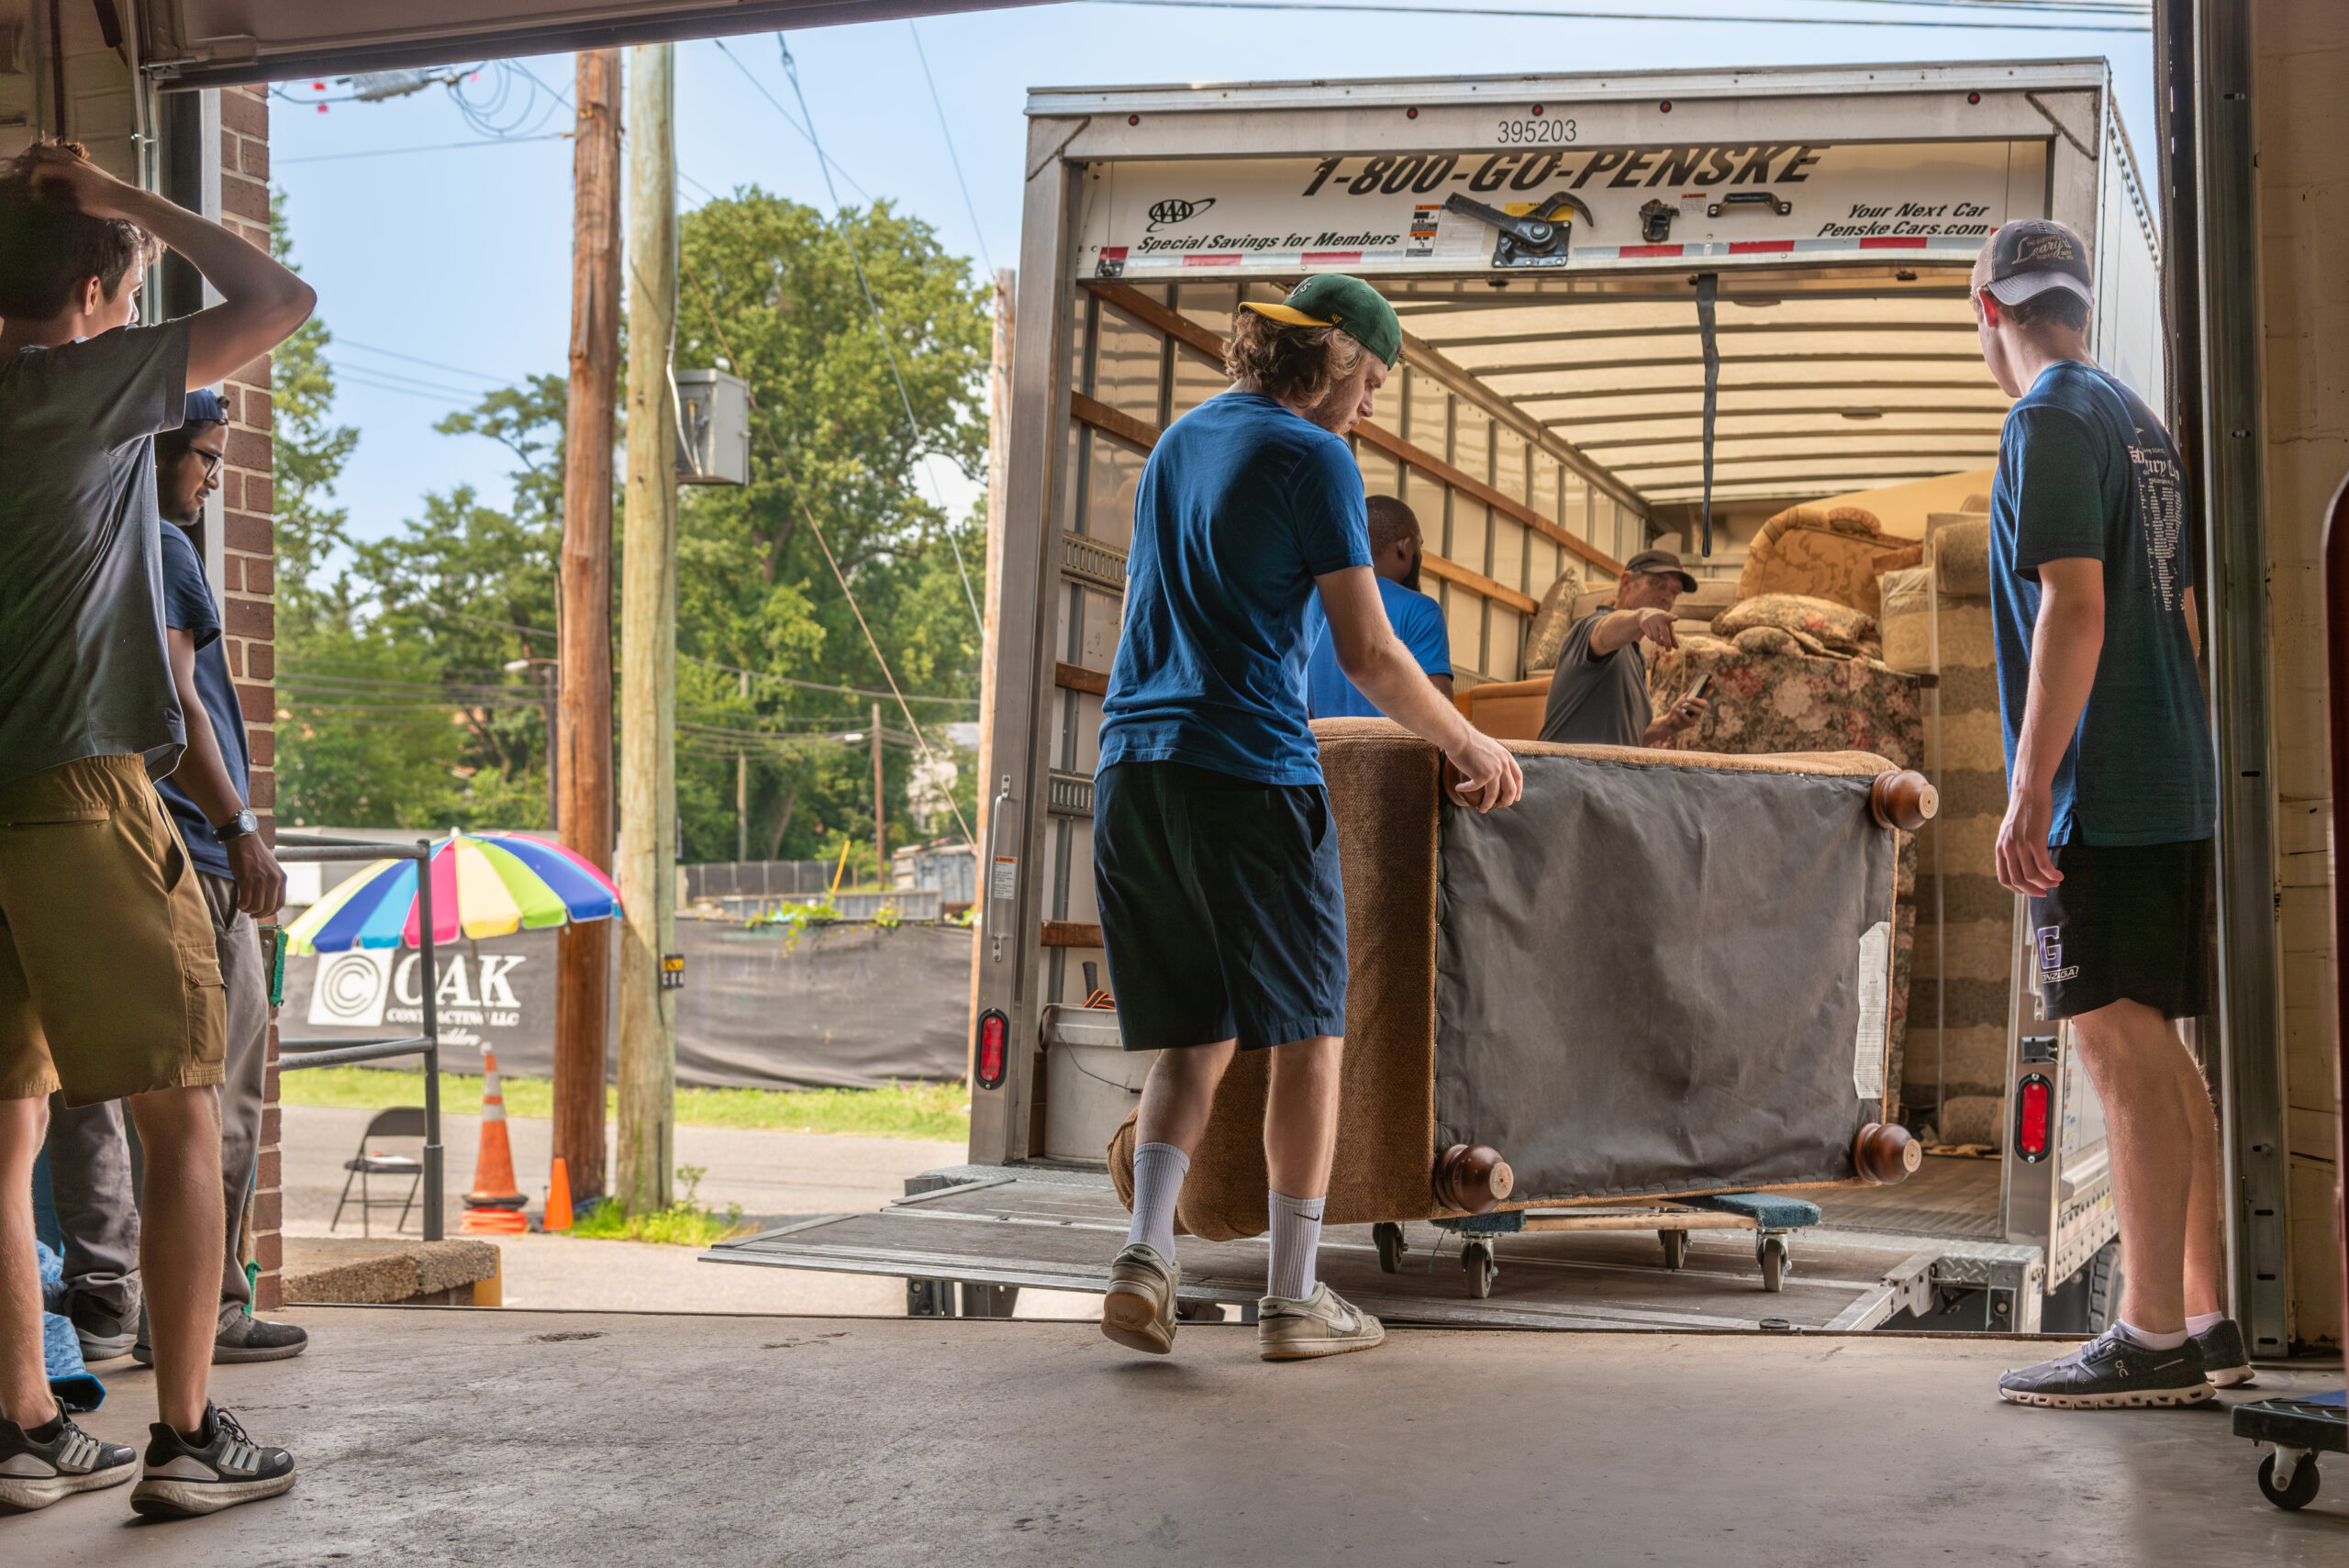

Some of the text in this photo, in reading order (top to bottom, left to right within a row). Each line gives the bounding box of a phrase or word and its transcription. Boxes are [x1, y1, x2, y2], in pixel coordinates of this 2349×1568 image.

[1497, 119, 1576, 143] 395203
[1302, 146, 1828, 196] 1-800-GO-PENSKE
[1152, 201, 1190, 222] AAA
[1848, 203, 1990, 218] Your Next Car
[1817, 221, 1989, 238] Penske Cars.com
[1137, 235, 1208, 254] Special
[1208, 234, 1280, 250] Savings
[1282, 233, 1312, 247] for
[1313, 232, 1401, 247] Members
[2038, 926, 2061, 970] G
[394, 952, 527, 1007] OAK
[490, 1011, 520, 1027] LLC
